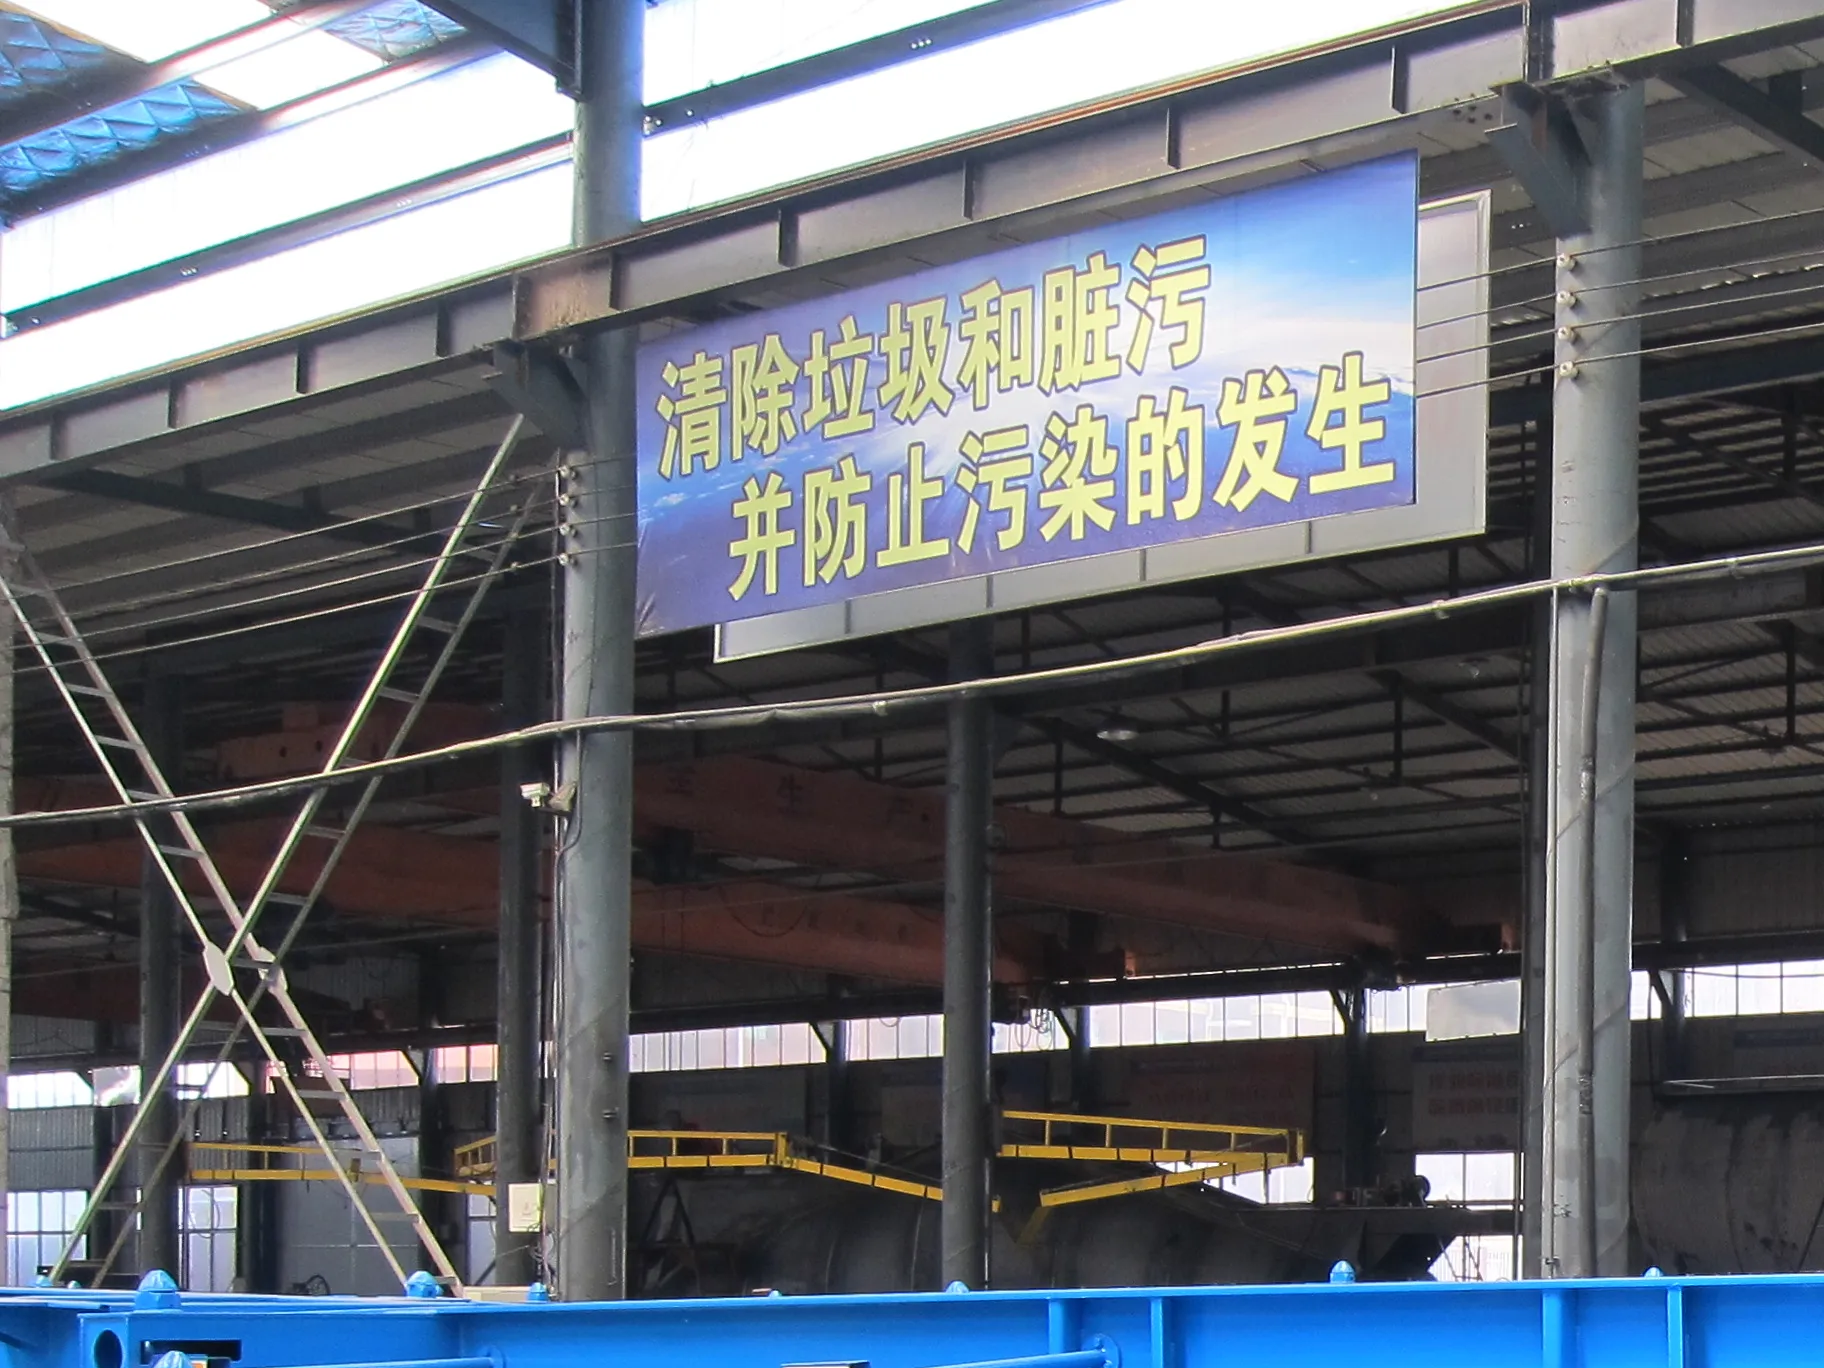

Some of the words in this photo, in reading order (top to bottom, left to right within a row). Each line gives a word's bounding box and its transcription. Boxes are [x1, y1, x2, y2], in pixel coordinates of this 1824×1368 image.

[656, 234, 1212, 480] 清除垃圾和脏污
[727, 352, 1397, 603] 并防止污染的发生
